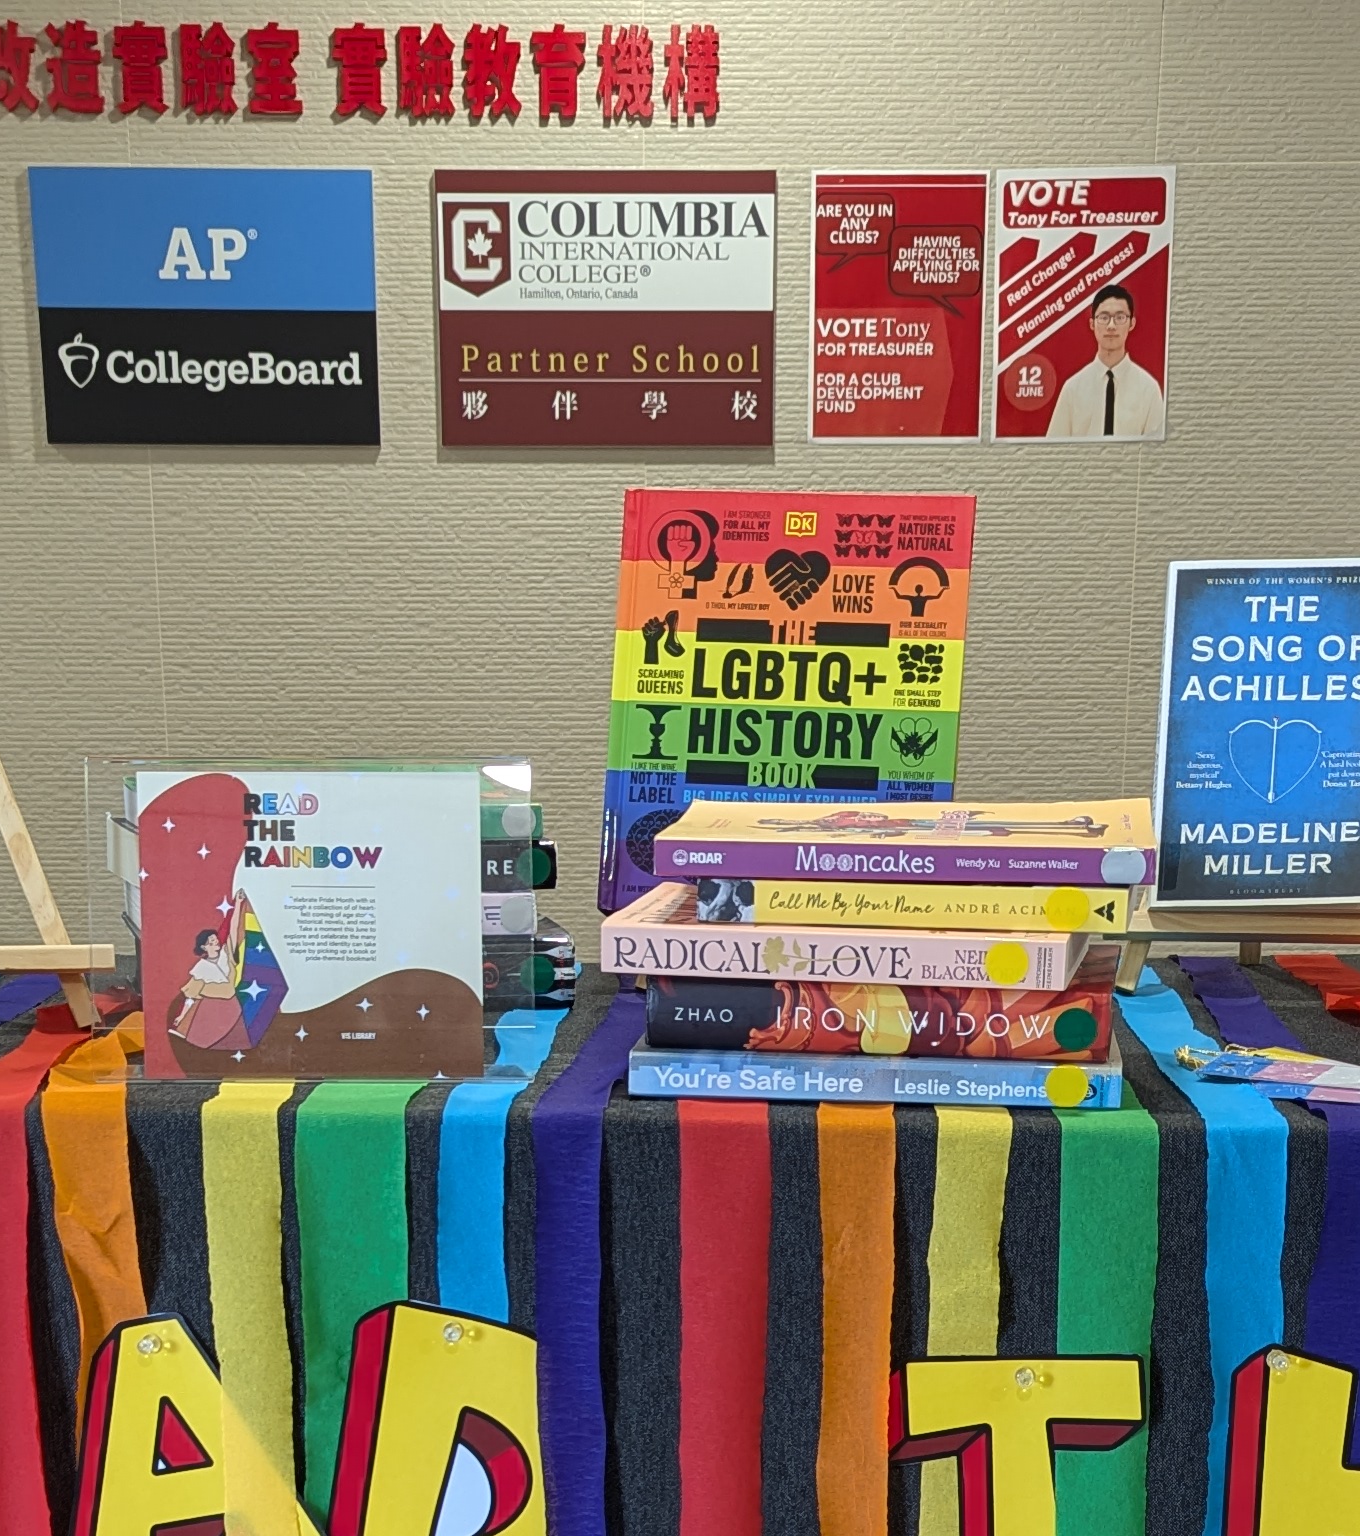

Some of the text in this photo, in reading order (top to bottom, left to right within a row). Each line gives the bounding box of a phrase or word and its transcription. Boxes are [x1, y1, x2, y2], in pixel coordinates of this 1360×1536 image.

[331, 22, 720, 119] 實驗教育機構
[1008, 180, 1091, 206] VOTE
[517, 200, 770, 239] COLUMBIA
[816, 204, 893, 217] ARE YOU IN
[1008, 209, 1159, 228] Tony For Treasurer
[840, 218, 869, 231] ANY
[830, 230, 879, 245] CLUBS?
[913, 236, 961, 249] HAVING
[519, 241, 730, 262] INTERNATIONAL
[898, 248, 976, 261] DIFFICULTIES
[893, 259, 980, 272] APPLYING FOR
[913, 271, 960, 285] FUNDS?
[519, 288, 638, 300] Hamilton, Ontario, Canada
[817, 317, 930, 342] VOTE Tony
[461, 344, 760, 374] Partner School
[817, 342, 934, 356] FOR TREASURER
[106, 351, 363, 393] CollegeBoard
[816, 373, 901, 386] FOR A CLUB
[1018, 366, 1042, 385] 12
[816, 386, 923, 400] DEVELOPMENT
[1015, 386, 1044, 398] JUNE
[816, 400, 856, 413] FUND
[788, 516, 814, 532] DK
[832, 573, 875, 594] LOVE
[1206, 577, 1246, 585] WINNER
[1249, 577, 1261, 585] OF
[1265, 577, 1284, 585] THE
[831, 594, 873, 614] WINS
[1244, 596, 1320, 623] THE
[771, 620, 817, 646] THE
[1190, 635, 1303, 662] SONG
[637, 668, 685, 680] SCREAMING
[690, 647, 888, 706] LGBTQ+
[637, 681, 684, 695] QUEENS
[687, 706, 884, 761] HISTORY
[747, 761, 817, 790] BOOK
[244, 793, 320, 816] READ
[244, 819, 296, 842] THE
[1179, 821, 1360, 845] MADELINE
[244, 846, 383, 869] RAINBOW
[688, 846, 1079, 876] ROAR Mooncakes Wendy Xu Suzanne Walker
[1204, 853, 1332, 877] MILLER
[769, 890, 1001, 916] Call Me By Your Name ANDRÉ
[613, 936, 912, 981] RADICAL LOVE
[673, 1006, 1053, 1041] ZHAO IRON WIDOW
[653, 1065, 1047, 1102] You're Safe Here Leslie Stephens
